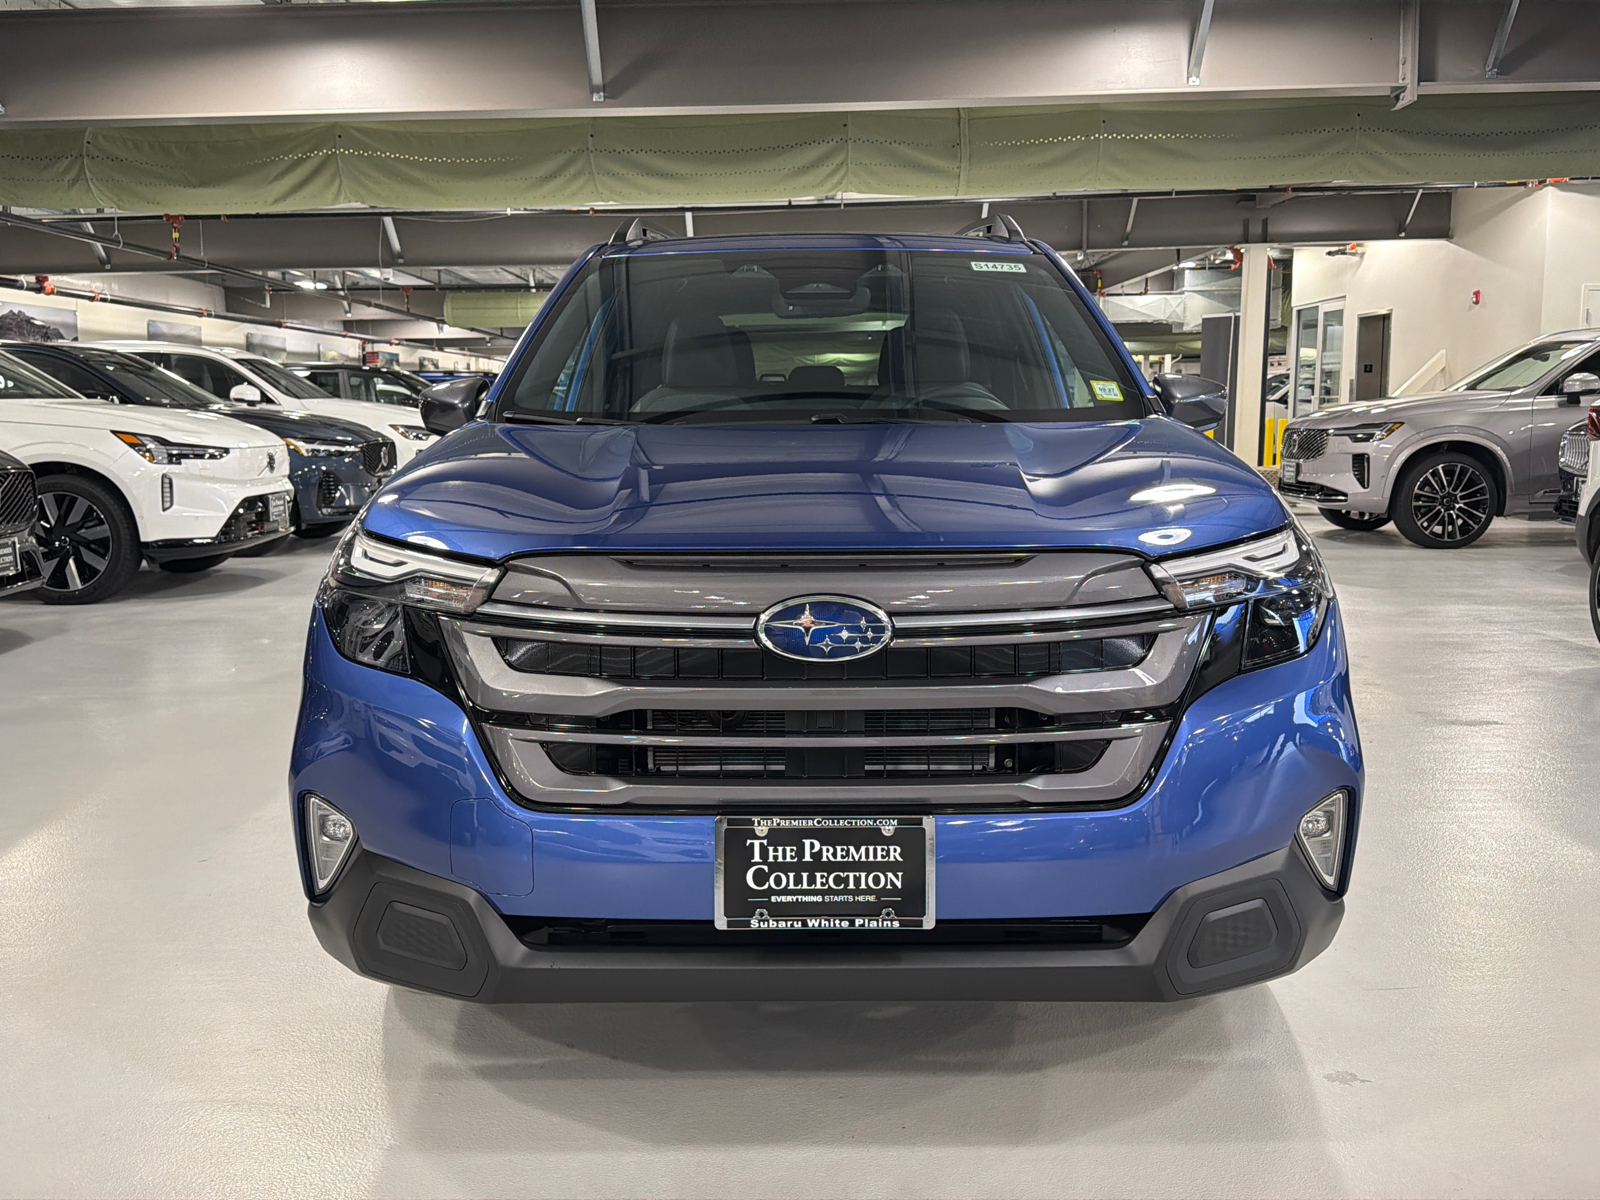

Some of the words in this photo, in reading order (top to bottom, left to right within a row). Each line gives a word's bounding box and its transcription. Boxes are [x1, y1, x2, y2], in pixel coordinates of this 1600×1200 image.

[974, 263, 1021, 271] S14735
[746, 839, 798, 862] THE
[802, 839, 904, 862] PREMIER
[746, 865, 904, 890] COLLECTION
[770, 895, 823, 903] EVERYTHING
[750, 919, 802, 928] Subaru
[807, 919, 850, 928] White
[855, 919, 900, 928] Plains
